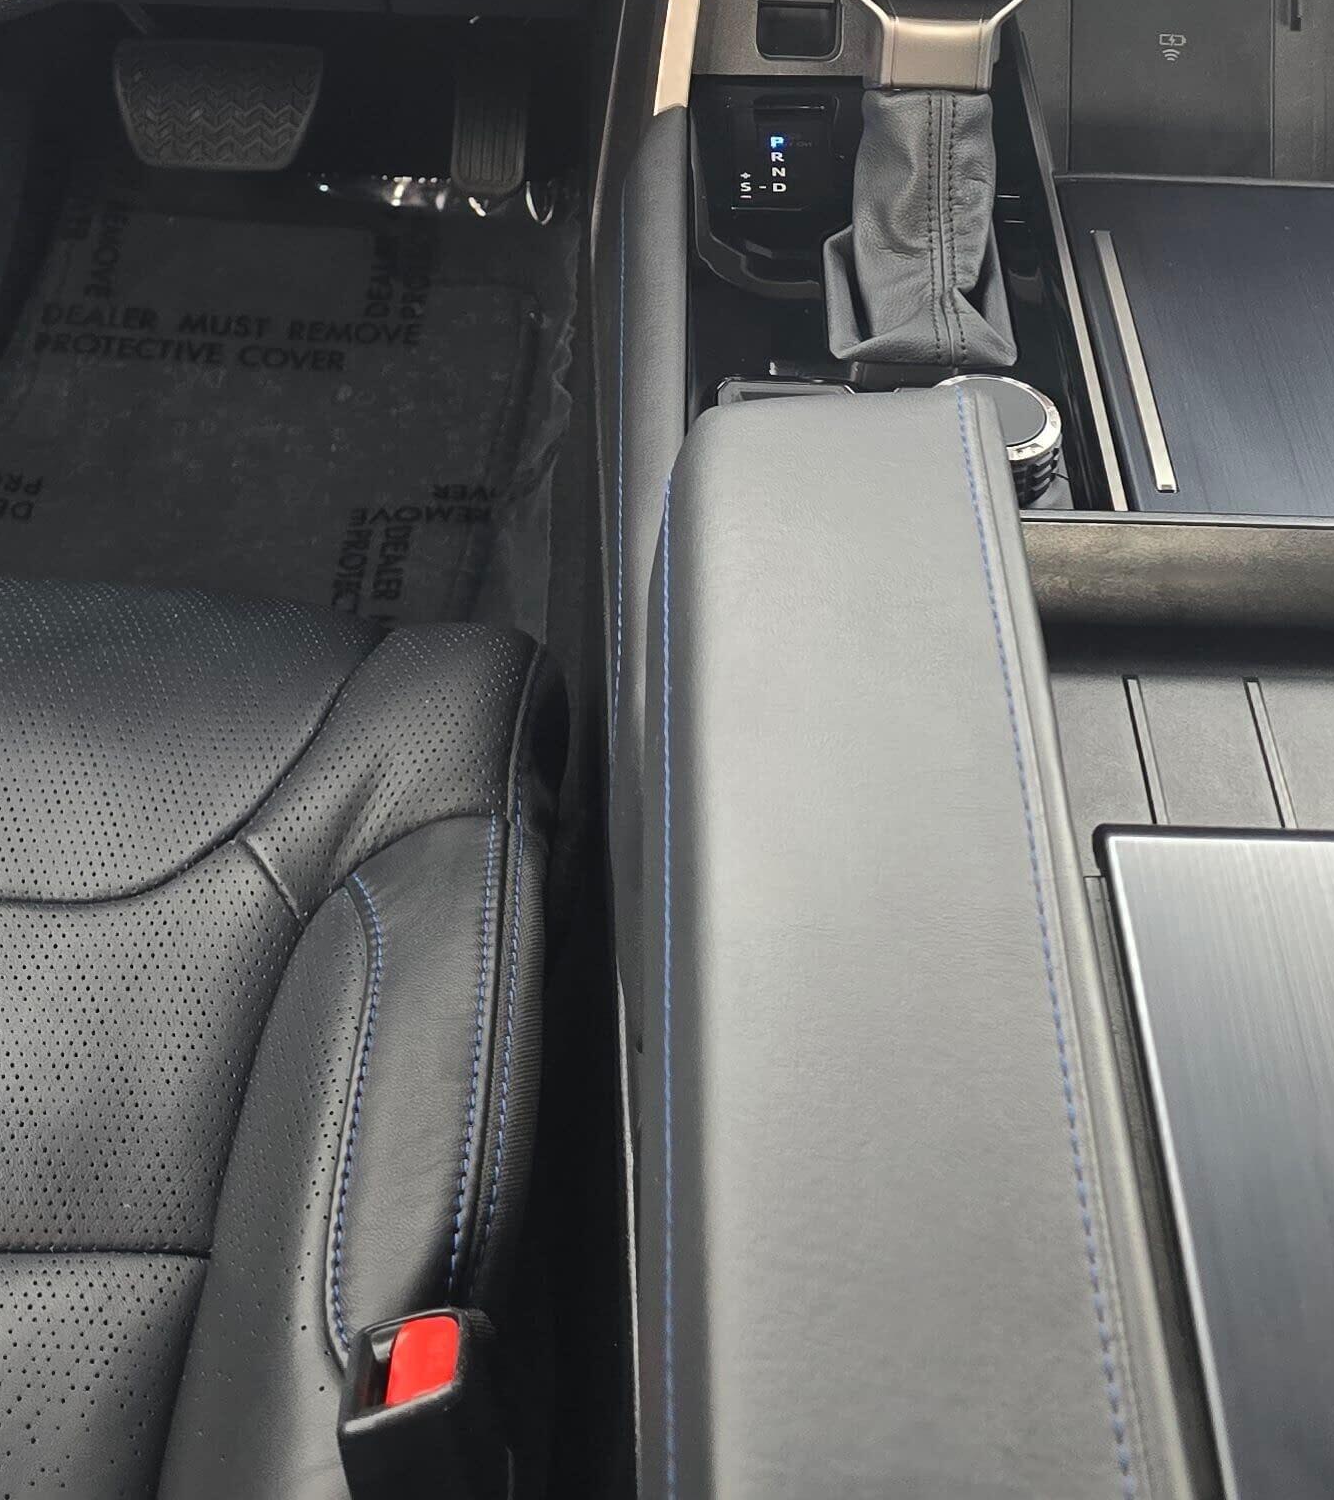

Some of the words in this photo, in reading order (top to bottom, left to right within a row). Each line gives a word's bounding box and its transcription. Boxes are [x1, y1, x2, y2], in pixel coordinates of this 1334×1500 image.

[770, 136, 785, 149] P
[770, 151, 785, 162] R
[771, 167, 786, 177] N
[740, 182, 752, 192] S
[772, 182, 787, 193] D
[41, 301, 159, 332] DEALER
[178, 312, 273, 340] MUST
[287, 320, 426, 347] REMOVE
[34, 331, 225, 366] PROTECTIVE
[237, 344, 348, 373] COVER
